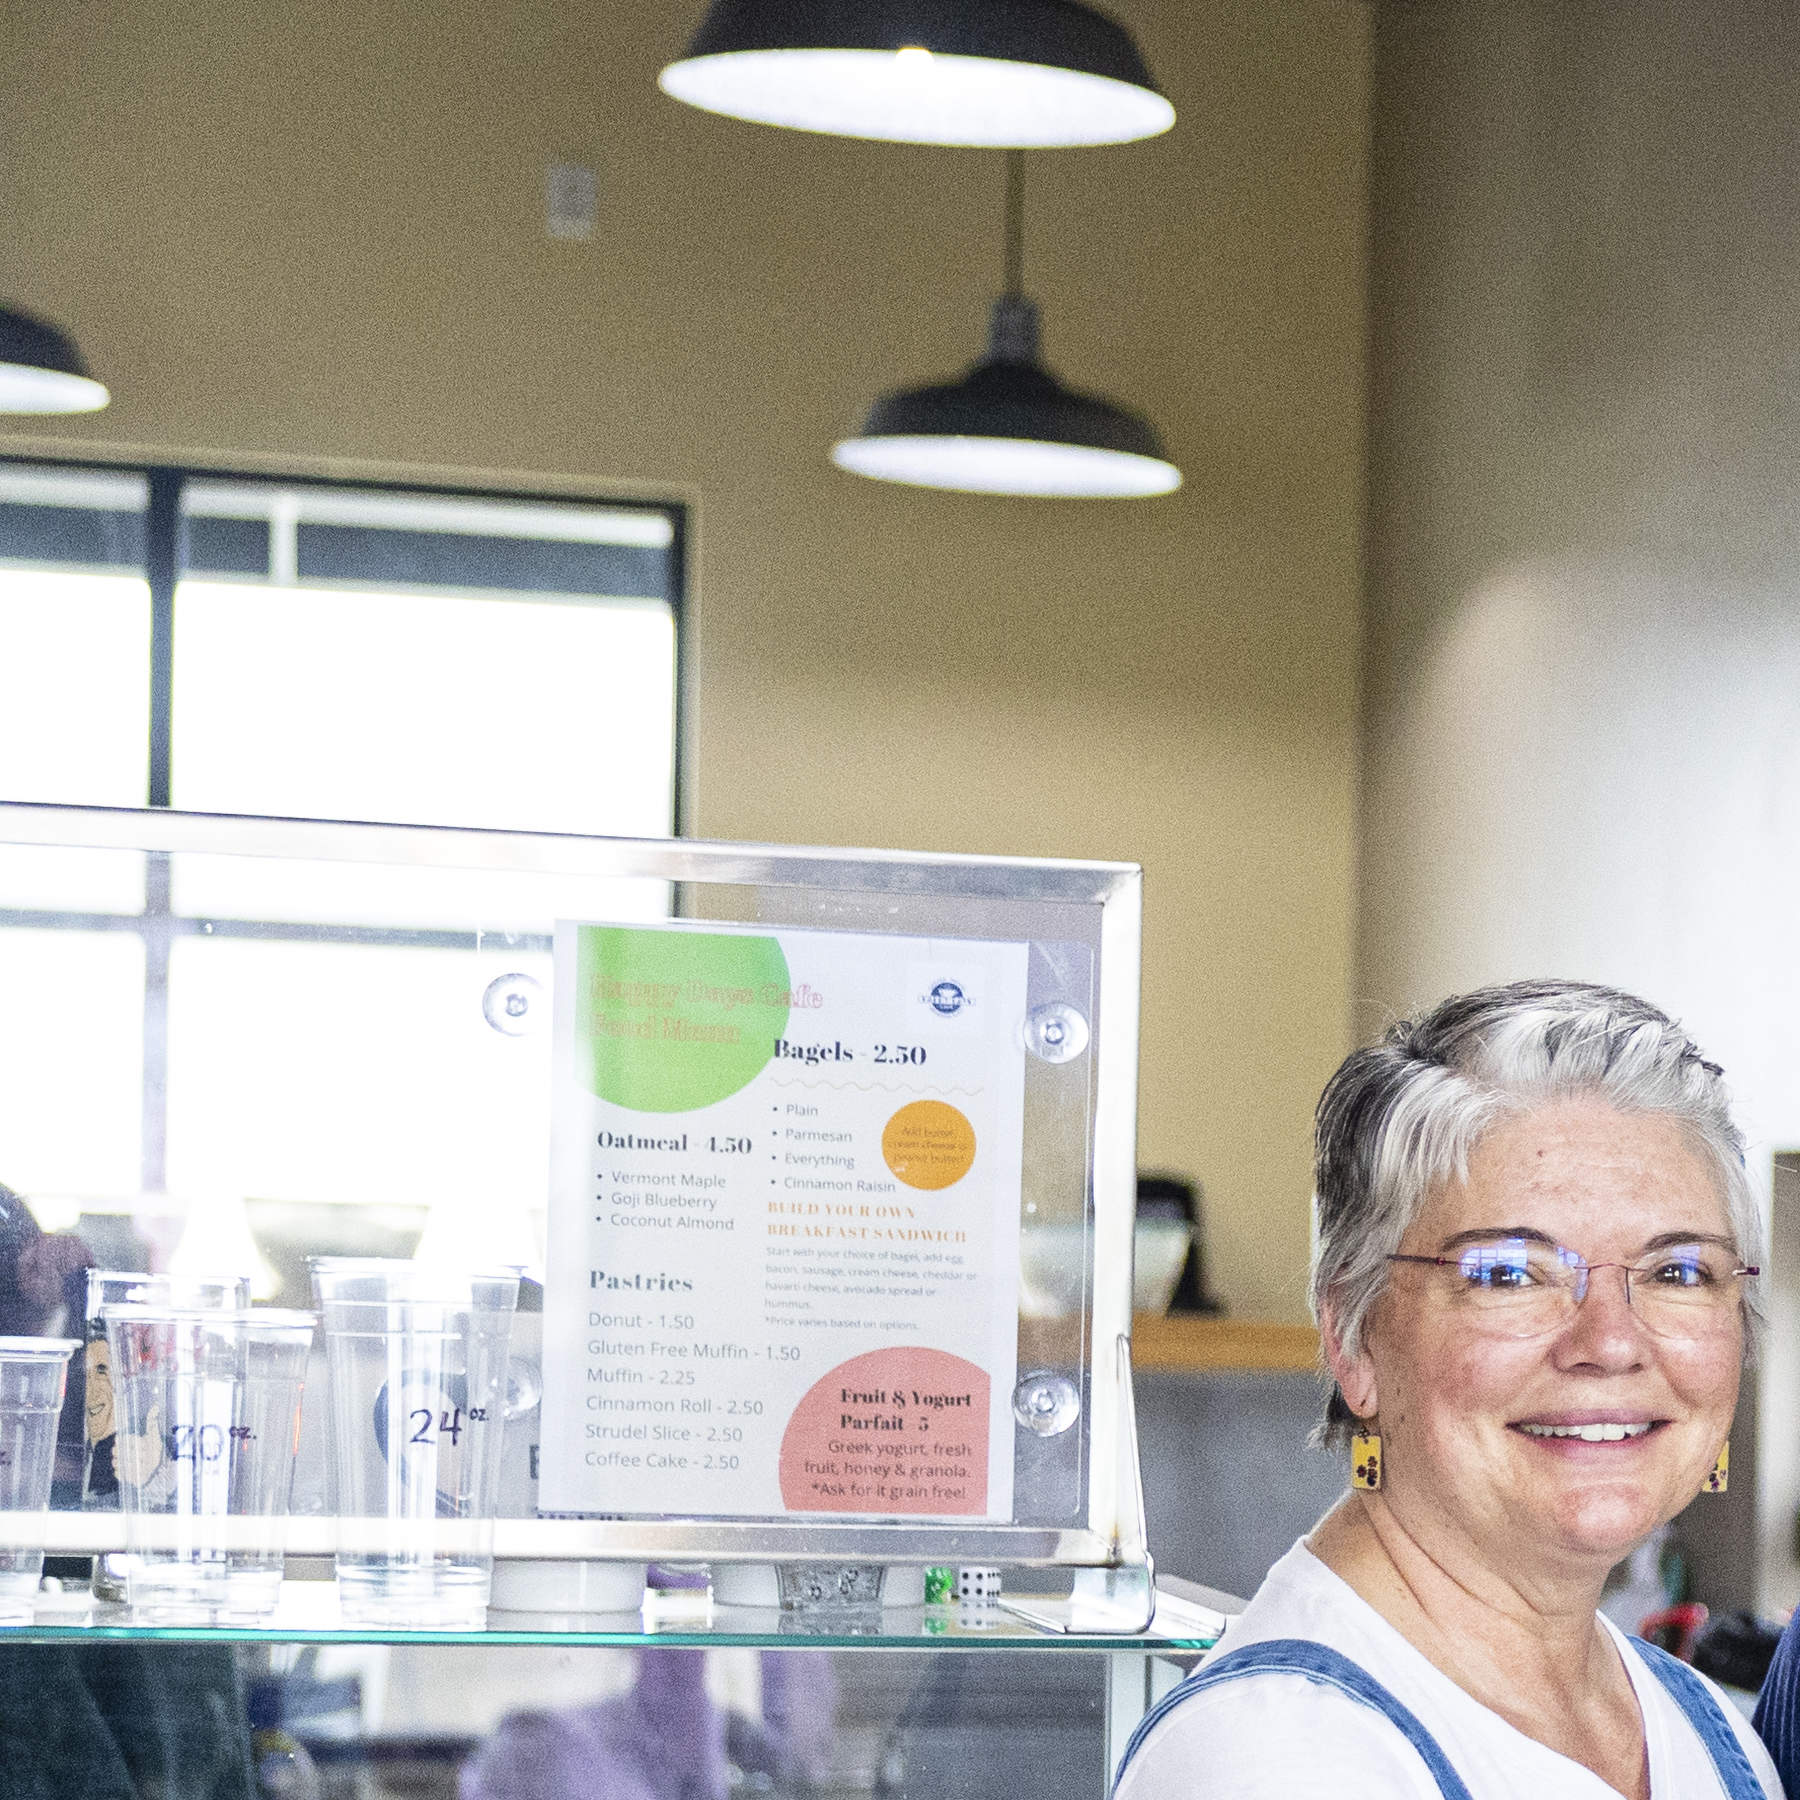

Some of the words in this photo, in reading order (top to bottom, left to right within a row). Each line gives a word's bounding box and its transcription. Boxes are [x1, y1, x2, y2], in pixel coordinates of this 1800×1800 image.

[773, 1039, 854, 1066] Bagels
[874, 1044, 927, 1065] 2.50
[786, 1104, 818, 1117] Plain
[597, 1131, 688, 1151] Oatmeal
[785, 1128, 852, 1143] Parmesan
[785, 1153, 855, 1169] Everything
[612, 1171, 676, 1186] Vermont
[681, 1173, 726, 1190] Maple
[784, 1176, 852, 1192] Cinnamon
[857, 1179, 896, 1193] Raisin
[611, 1192, 641, 1207] Goji
[645, 1193, 717, 1211] Blueberry
[611, 1213, 672, 1229] Coconut
[677, 1215, 734, 1230] Almond
[767, 1224, 870, 1240] BREAKFAST
[874, 1227, 967, 1243] SANDWICH
[589, 1270, 693, 1291] Pastries
[588, 1312, 641, 1328] Donut
[660, 1315, 694, 1329] 1.50
[587, 1340, 645, 1356] Gluten
[651, 1343, 688, 1357] Free
[693, 1343, 749, 1359] Muffin
[767, 1346, 801, 1361] 1.50
[587, 1367, 643, 1384] Muffin
[660, 1370, 696, 1385] 2.25
[586, 1395, 675, 1414] Cinnamon
[680, 1398, 712, 1414] Roll
[727, 1400, 764, 1416] 2.50
[841, 1388, 887, 1405] Fruit
[911, 1390, 971, 1409] Yogurt
[409, 1408, 462, 1446] 24
[840, 1414, 904, 1431] Parfait
[585, 1424, 648, 1440] Strudel
[653, 1424, 691, 1441] Slice
[706, 1427, 743, 1443] 2.50
[828, 1439, 872, 1453] Greek
[933, 1441, 972, 1456] fresh
[585, 1452, 641, 1468] Coffee
[646, 1453, 689, 1469] Cake
[703, 1454, 740, 1470] 2.50
[844, 1461, 889, 1478] honey
[850, 1483, 872, 1497] for
[890, 1484, 927, 1500] grain
